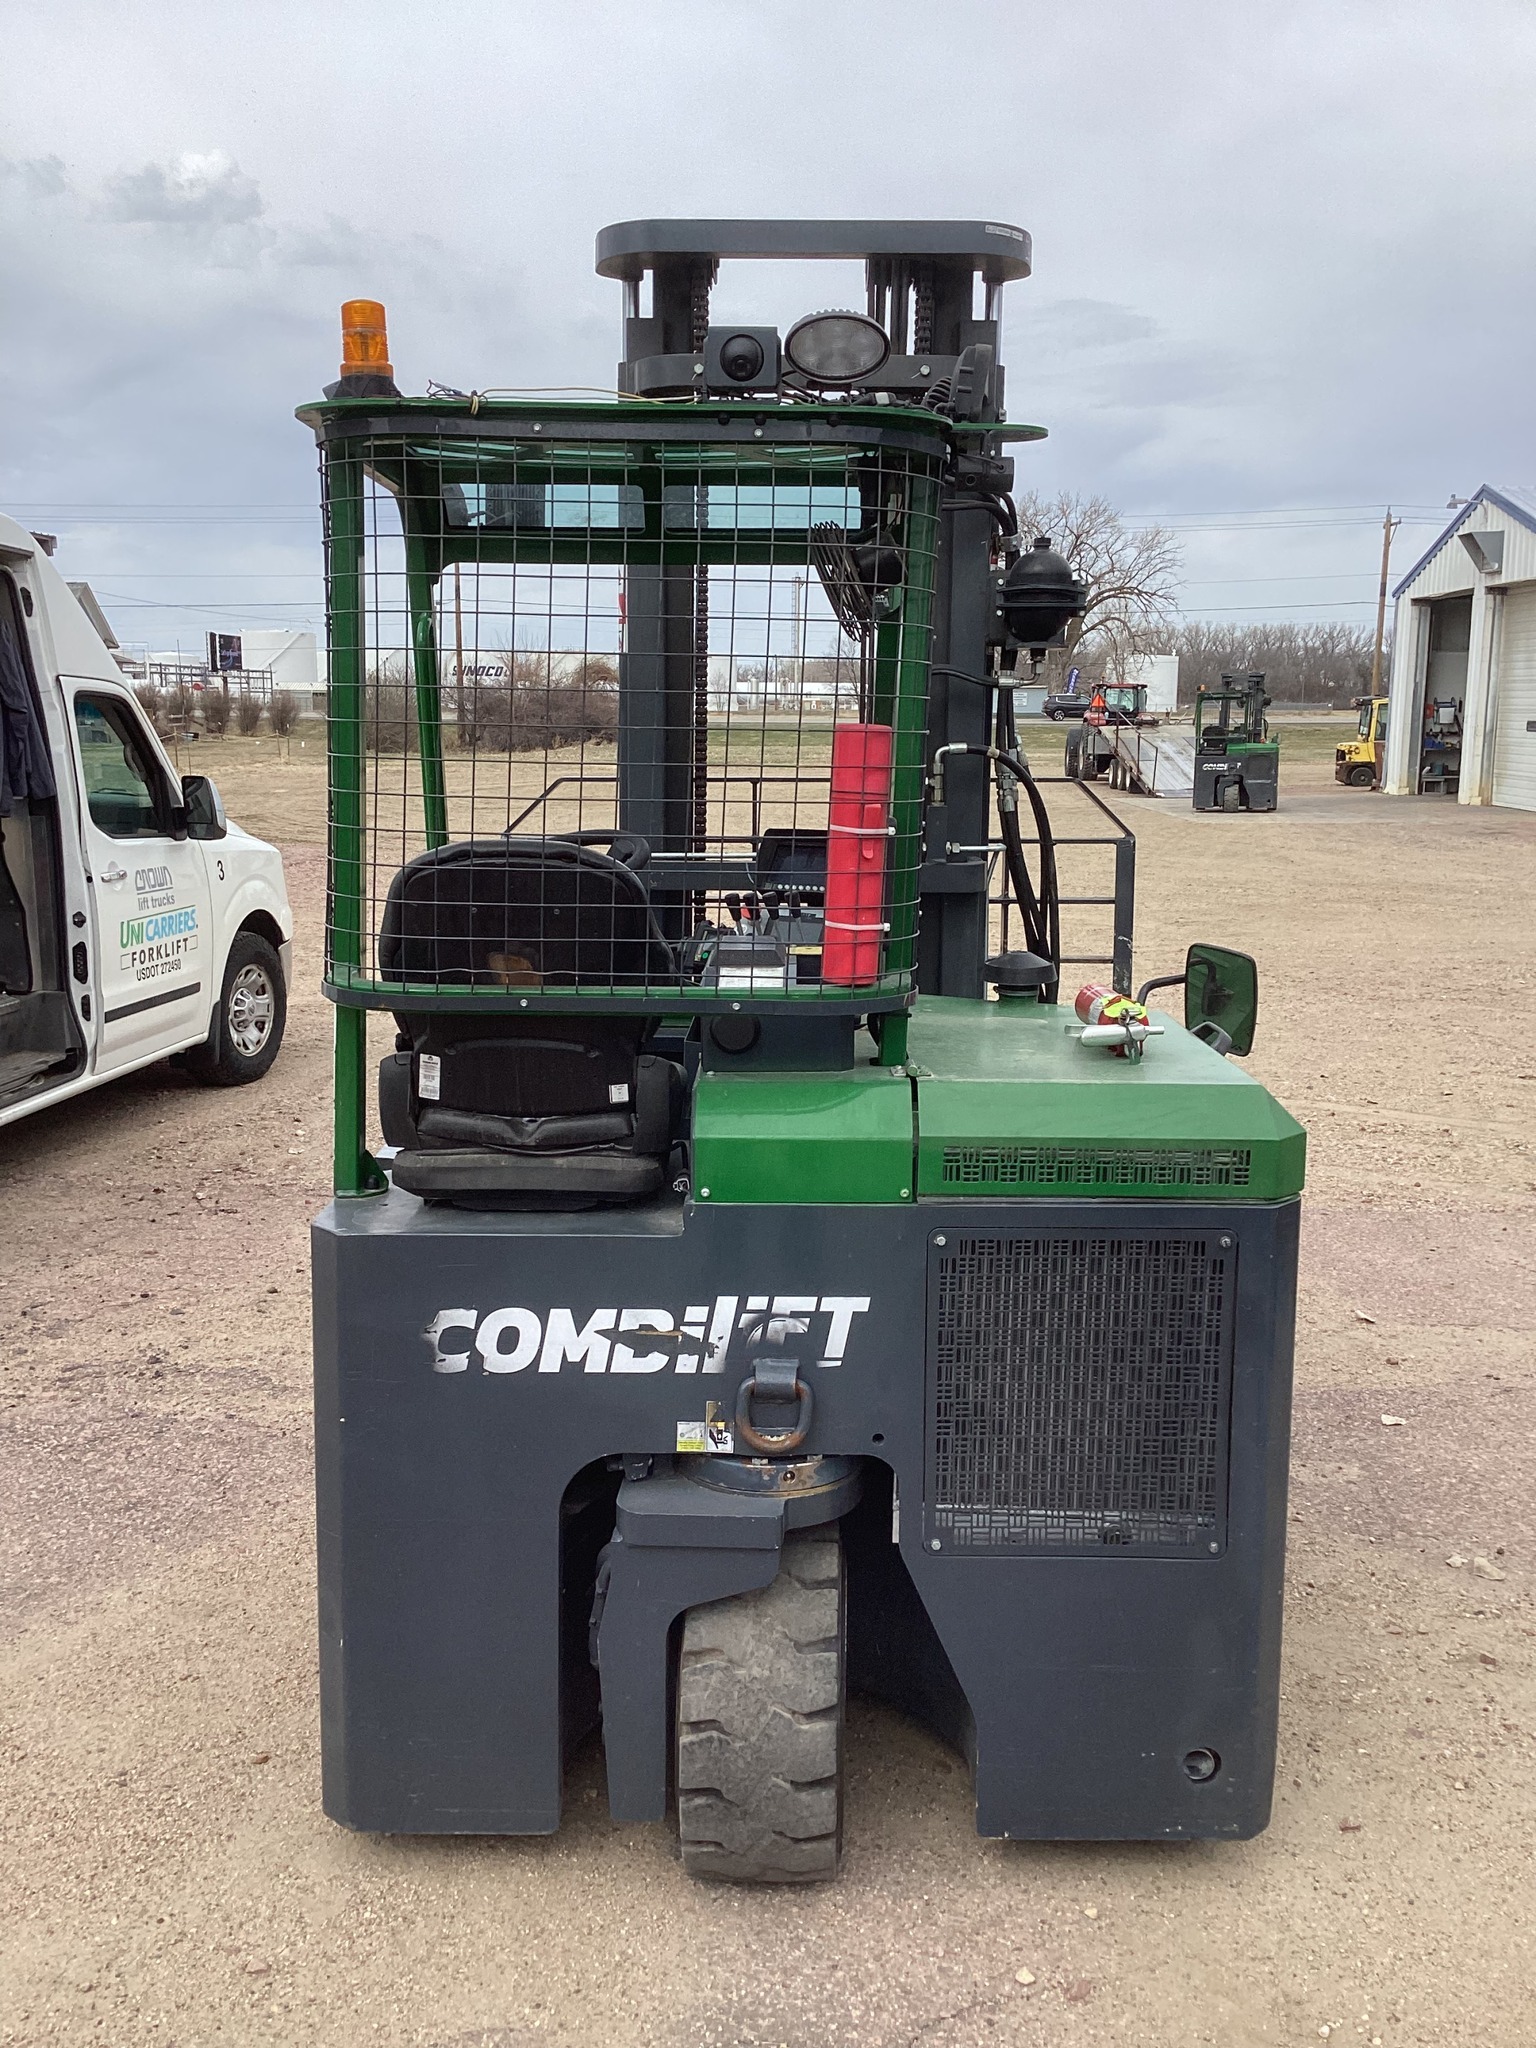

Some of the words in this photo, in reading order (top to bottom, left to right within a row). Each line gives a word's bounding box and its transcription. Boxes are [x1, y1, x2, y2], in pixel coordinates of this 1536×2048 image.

[216, 860, 225, 881] 3
[138, 896, 150, 911] lift
[151, 893, 176, 909] trucks
[131, 938, 189, 968] FORKLIFT
[136, 964, 160, 981] USDOT
